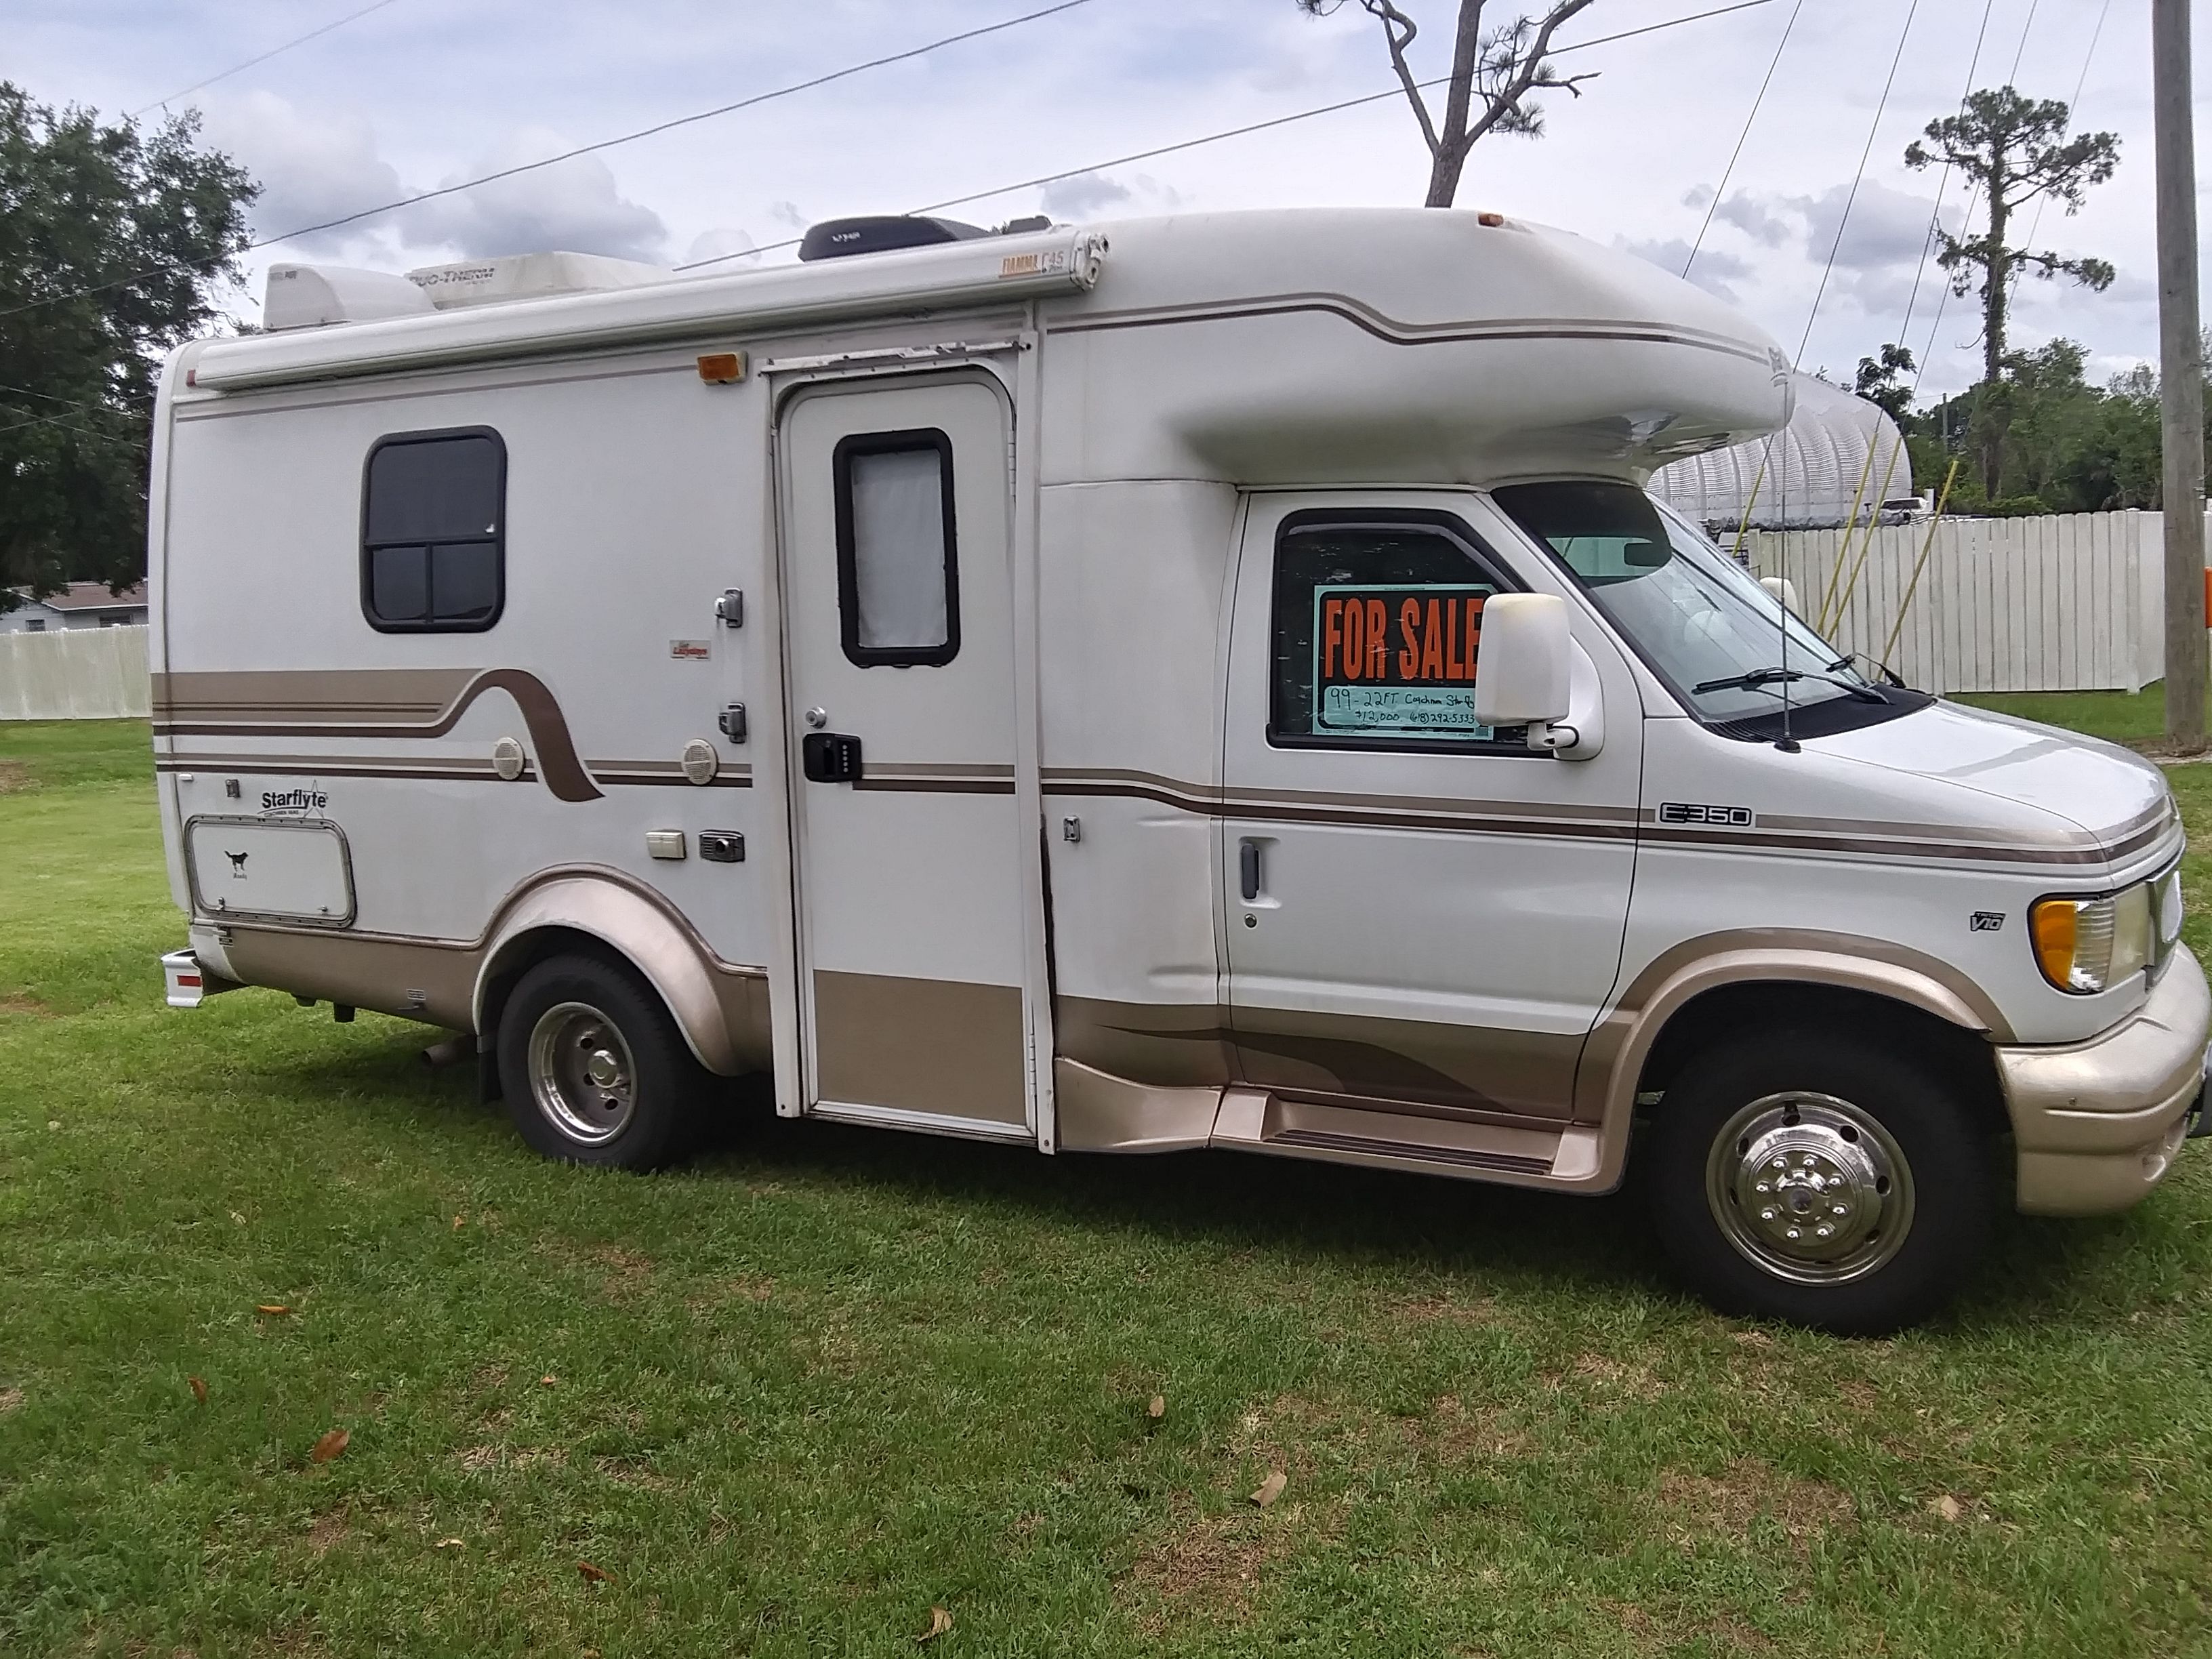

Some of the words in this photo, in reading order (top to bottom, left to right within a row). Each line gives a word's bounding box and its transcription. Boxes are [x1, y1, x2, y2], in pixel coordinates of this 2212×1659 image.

[1325, 597, 1386, 680] FOR
[1399, 597, 1484, 680] SALE
[1330, 688, 1351, 710] 99
[262, 789, 327, 809] Starflyte
[1971, 916, 2001, 931] V10
